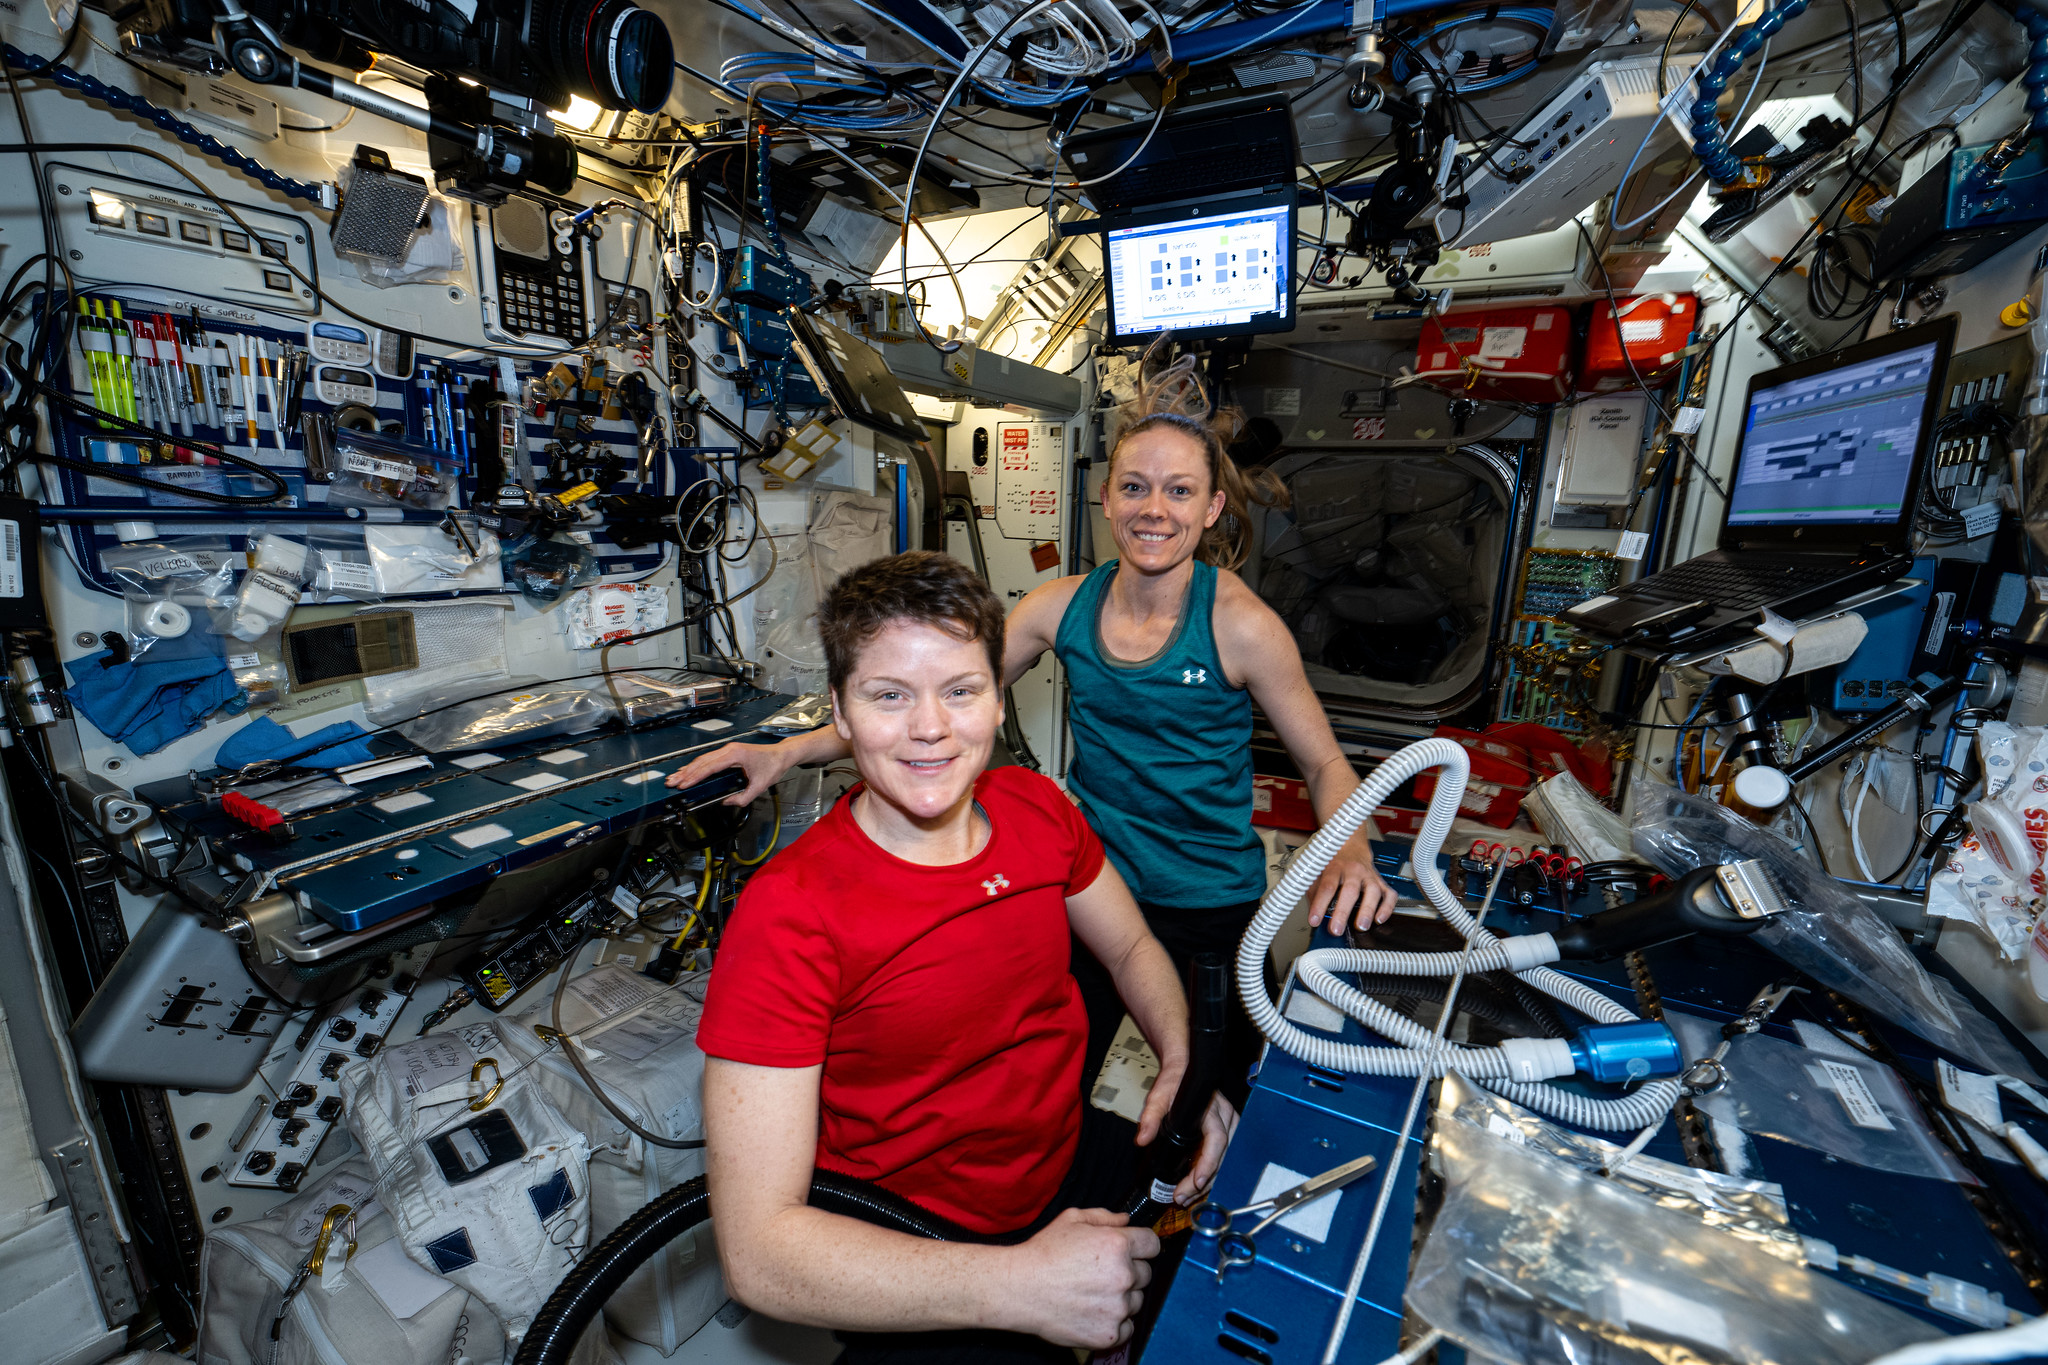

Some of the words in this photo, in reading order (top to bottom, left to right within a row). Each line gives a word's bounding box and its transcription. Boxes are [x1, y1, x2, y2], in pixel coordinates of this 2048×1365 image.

[149, 193, 179, 205] CAUTION
[184, 201, 198, 210] AND
[202, 205, 230, 217] WARNIN
[217, 309, 256, 321] SUPPLIES
[1359, 421, 1381, 435] EXIT
[166, 470, 201, 481] BANDAID
[376, 1019, 388, 1032] VDC
[316, 1054, 327, 1065] OFF
[275, 1120, 287, 1132] OFF
[309, 1133, 319, 1143] 28
[299, 1145, 312, 1160] VDC
